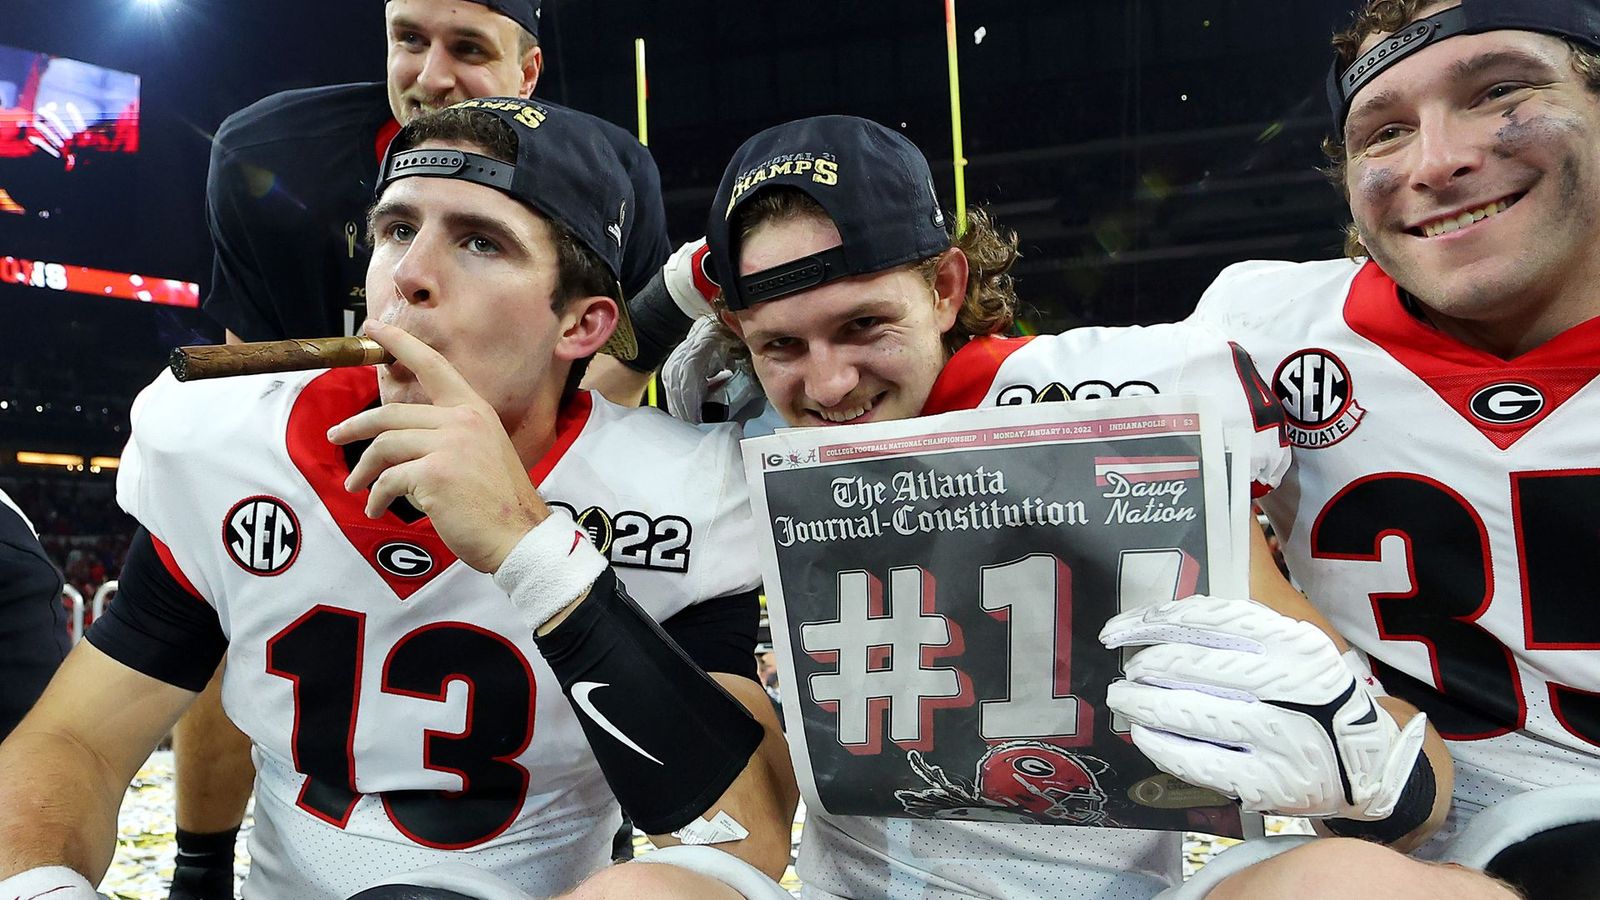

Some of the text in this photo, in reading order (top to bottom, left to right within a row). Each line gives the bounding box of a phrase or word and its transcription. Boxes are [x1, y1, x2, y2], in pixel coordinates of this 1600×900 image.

[1279, 354, 1345, 422] SEC
[1470, 383, 1544, 423] G
[826, 447, 854, 456] COLLEGE
[854, 443, 888, 454] FOOTBALL
[888, 440, 922, 450] NATIONAL
[922, 434, 977, 446] CHAMPIONSHIP
[1027, 427, 1060, 437] JANUARY
[1073, 426, 1092, 434] 2022
[1109, 419, 1166, 431] INDIANAPOLIS
[1286, 419, 1349, 446] ADUATE
[831, 465, 1008, 511] The Atlanta
[1103, 472, 1187, 505] Dawg
[775, 496, 1089, 548] Journal-Constitution
[1104, 497, 1197, 525] Nation
[231, 501, 294, 570] SEC
[376, 542, 433, 577] G
[265, 603, 538, 851] 13
